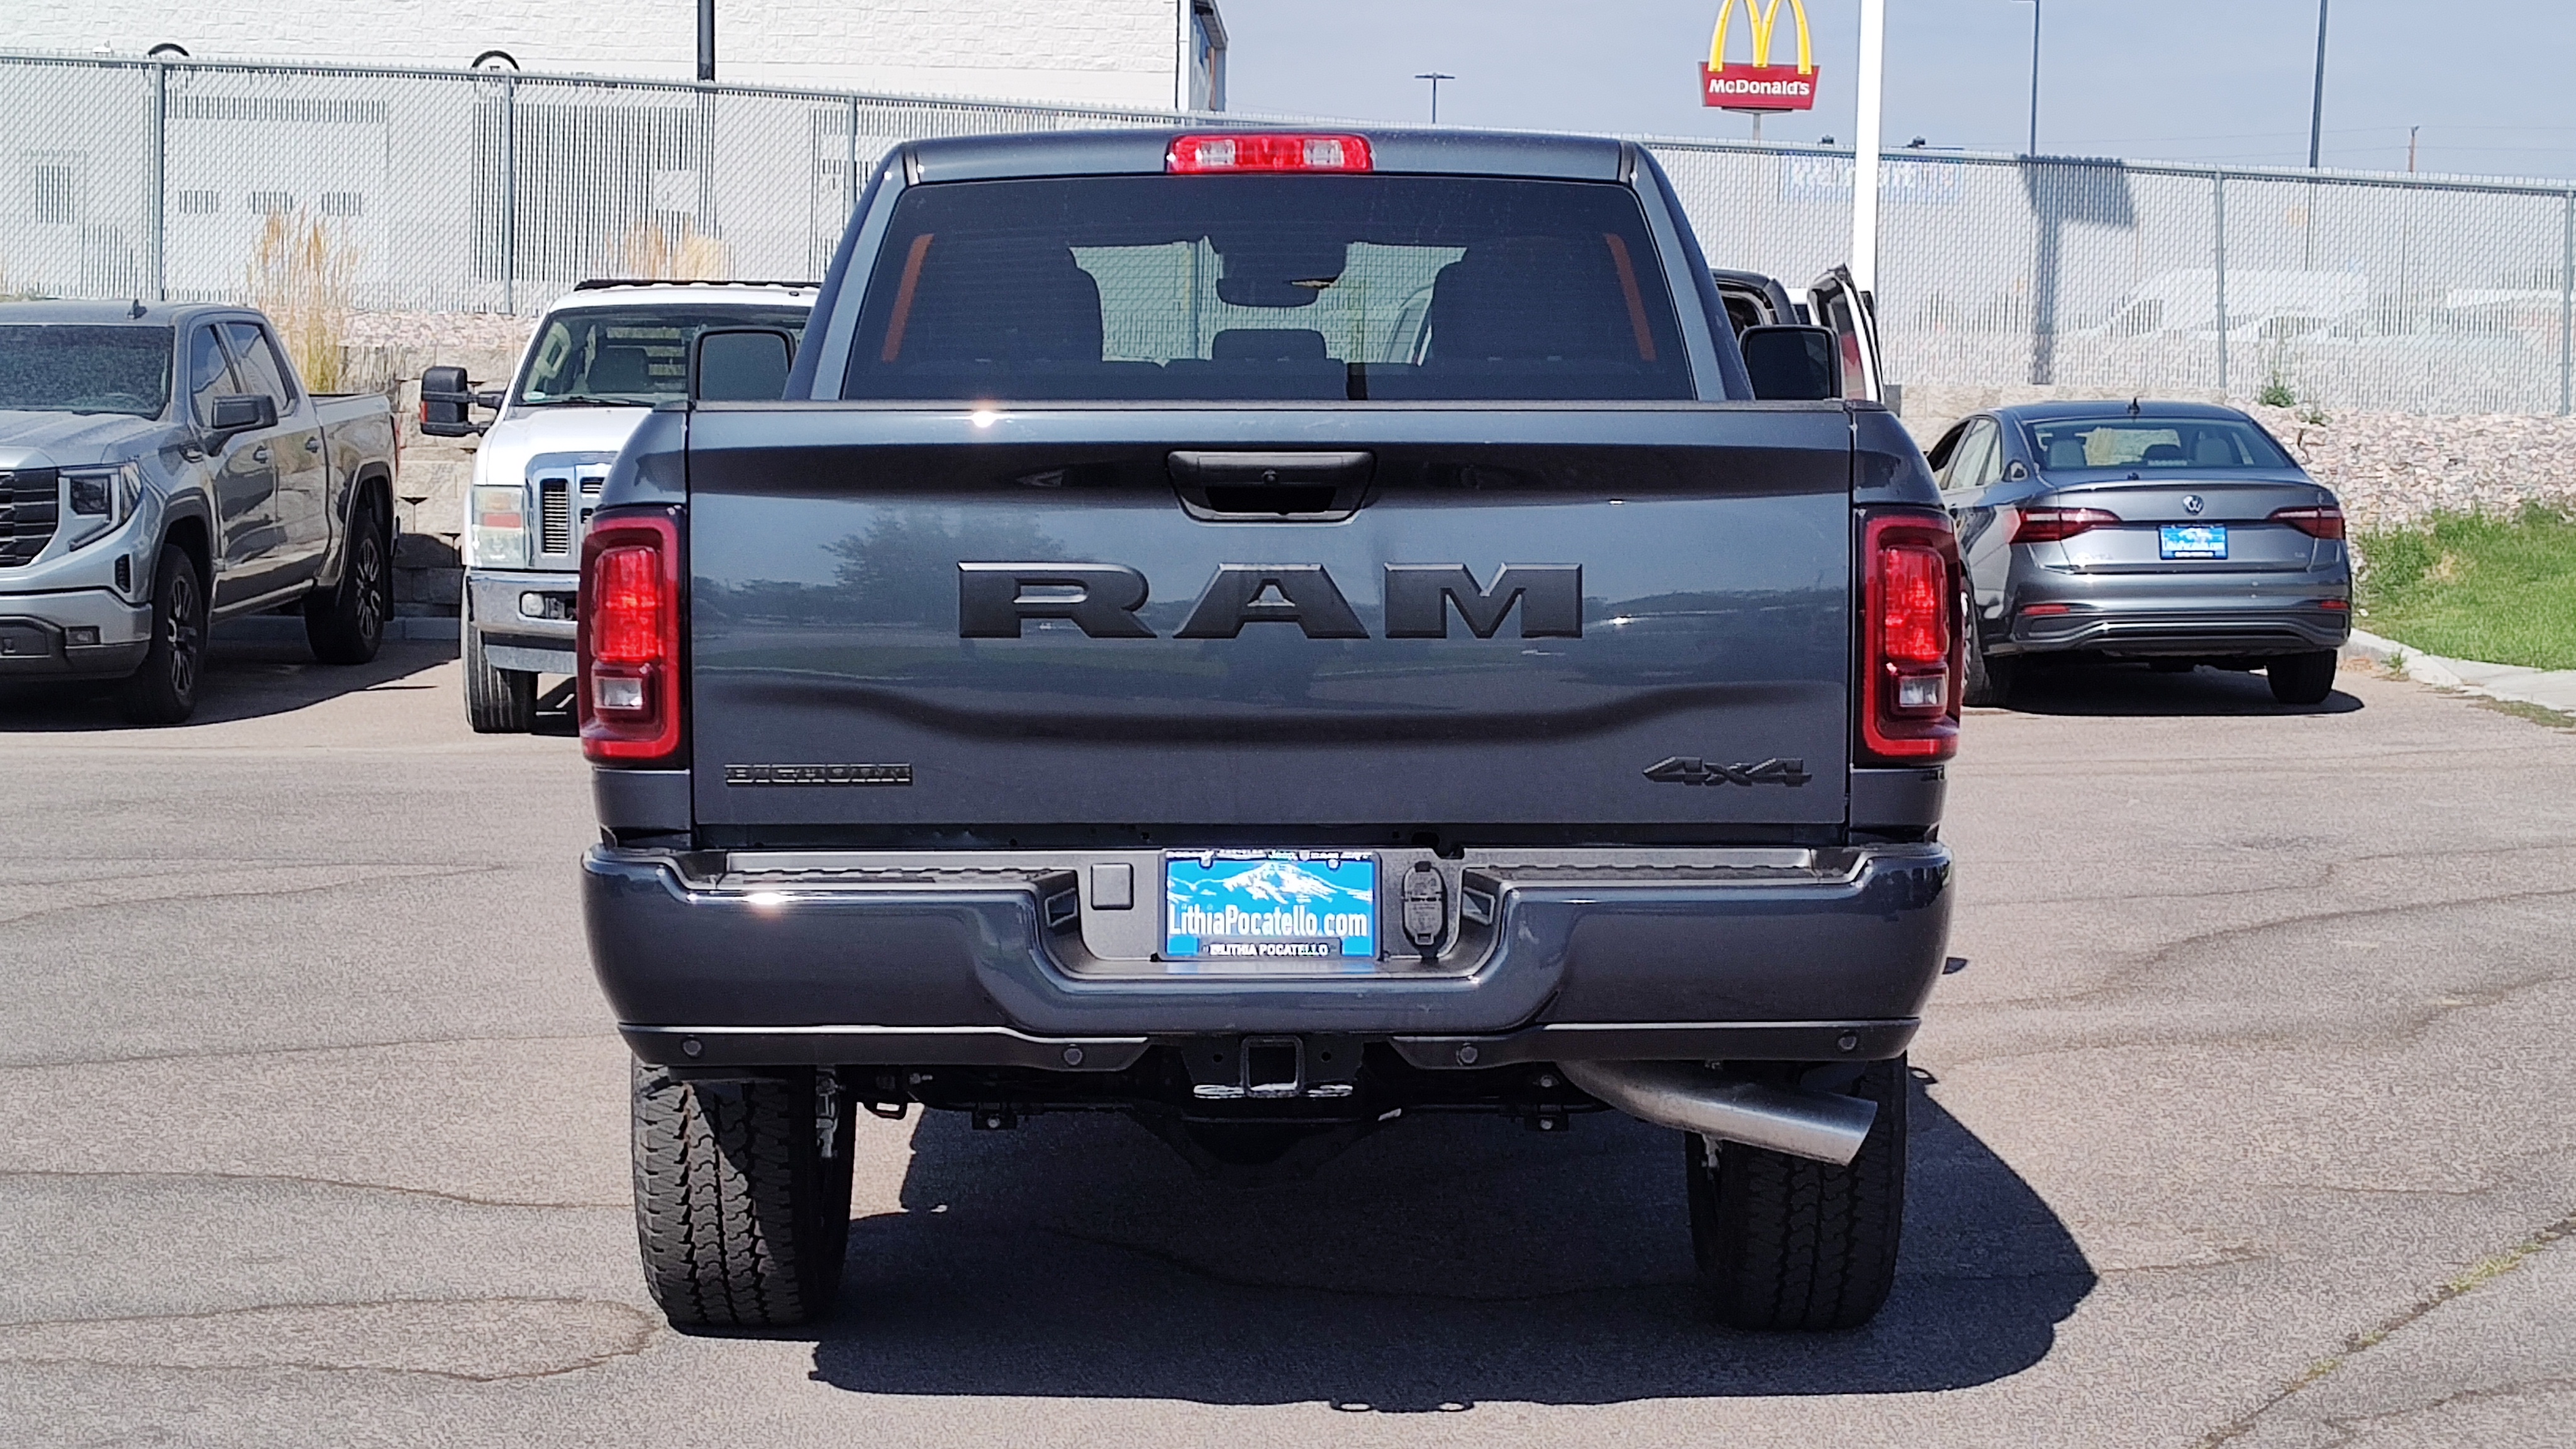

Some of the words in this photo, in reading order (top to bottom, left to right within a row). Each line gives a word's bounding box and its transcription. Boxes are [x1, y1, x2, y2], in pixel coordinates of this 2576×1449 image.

[1709, 79, 1810, 95] McDonald's
[957, 560, 1583, 639] RAM
[1169, 904, 1368, 936] LithiaPocatello.com
[1258, 943, 1328, 955] POCATELLO
